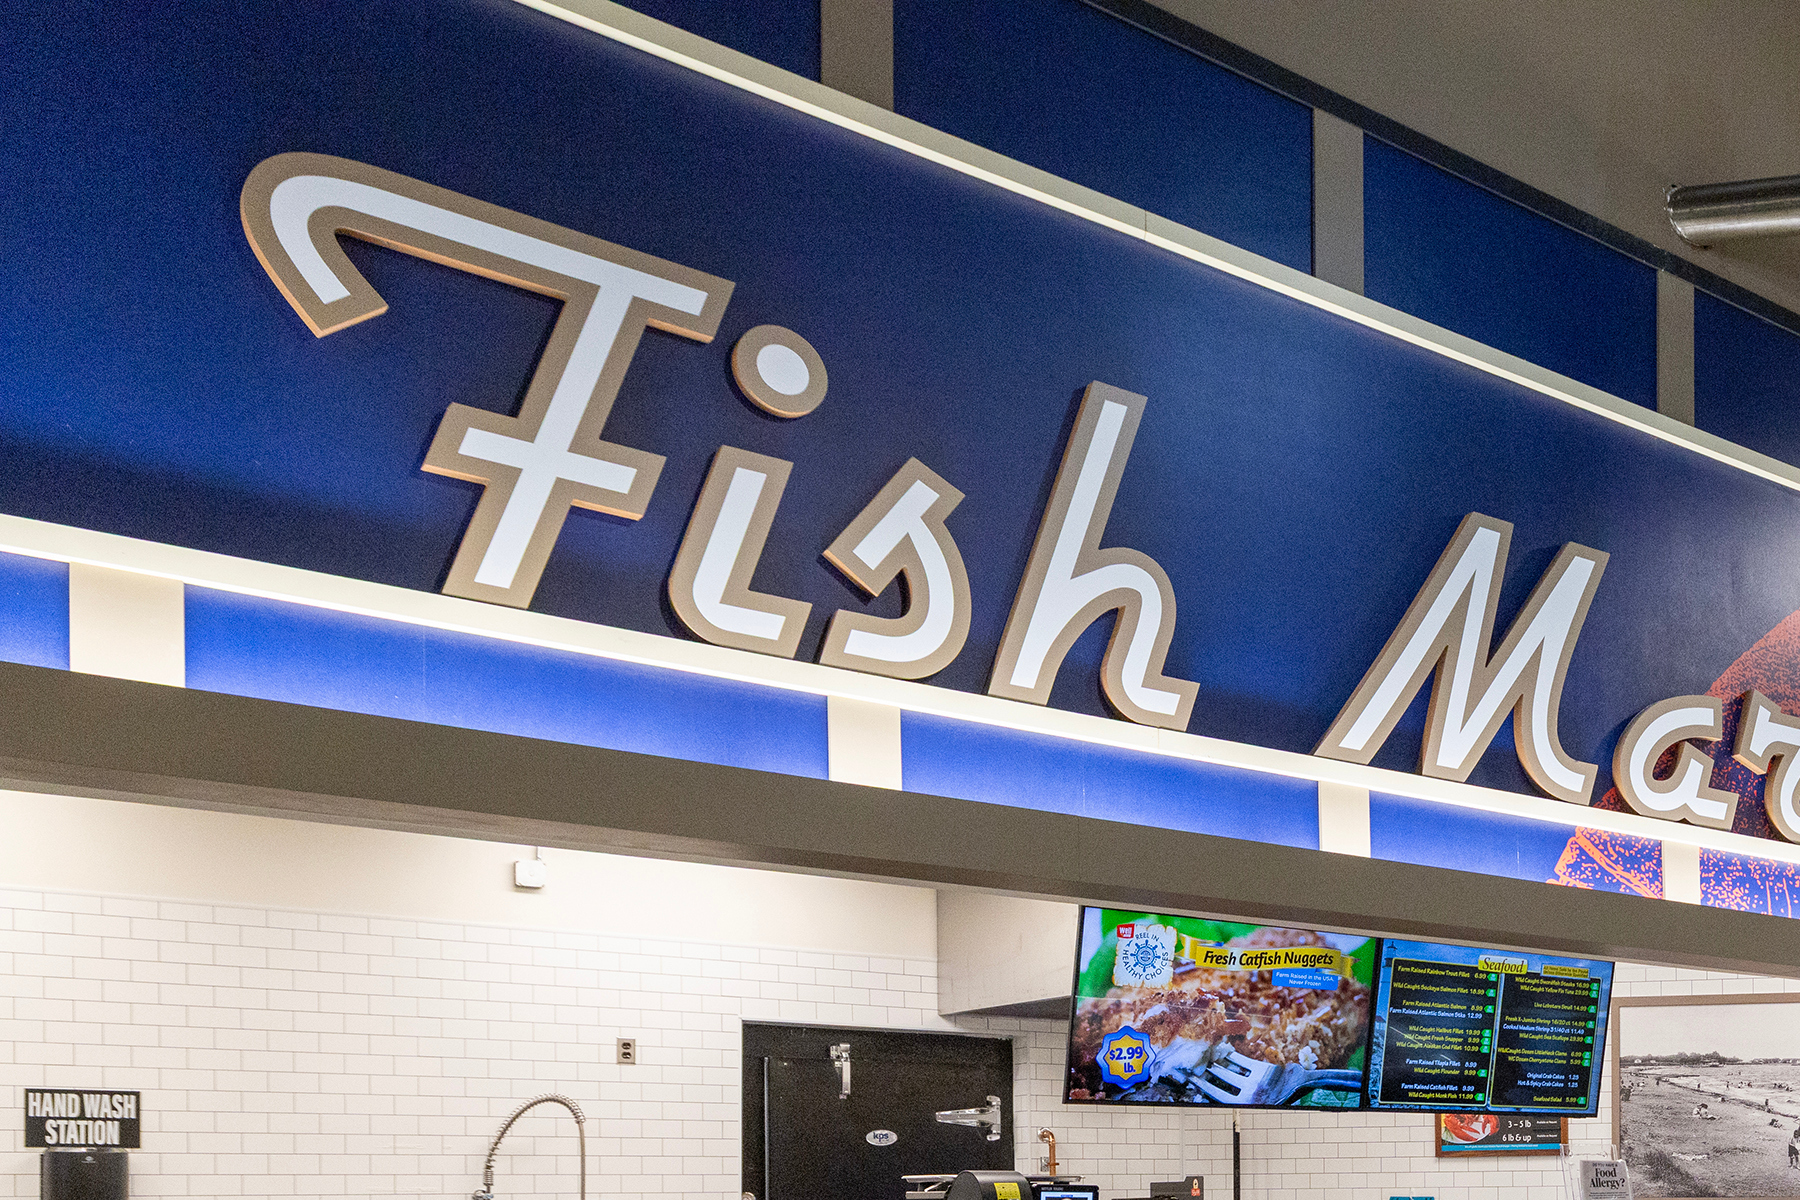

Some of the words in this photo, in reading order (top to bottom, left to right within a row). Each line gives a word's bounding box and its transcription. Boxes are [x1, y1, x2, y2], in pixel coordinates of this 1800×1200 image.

[240, 151, 1200, 732] Fish
[1123, 950, 1143, 980] HEALTHY
[1145, 951, 1169, 980] CHOICES
[1204, 952, 1236, 966] Fresh
[1239, 952, 1280, 966] Catfish
[1284, 952, 1334, 967] Nuggets
[1482, 957, 1524, 973] Seafood
[1109, 1047, 1144, 1062] $2.99
[1123, 1062, 1136, 1074] lb.
[28, 1092, 80, 1118] HAND
[83, 1094, 136, 1119] WASH
[45, 1120, 120, 1145] STATION
[873, 1132, 889, 1142] kps
[1596, 1168, 1617, 1177] Food
[1590, 1178, 1625, 1189] Allergy?
